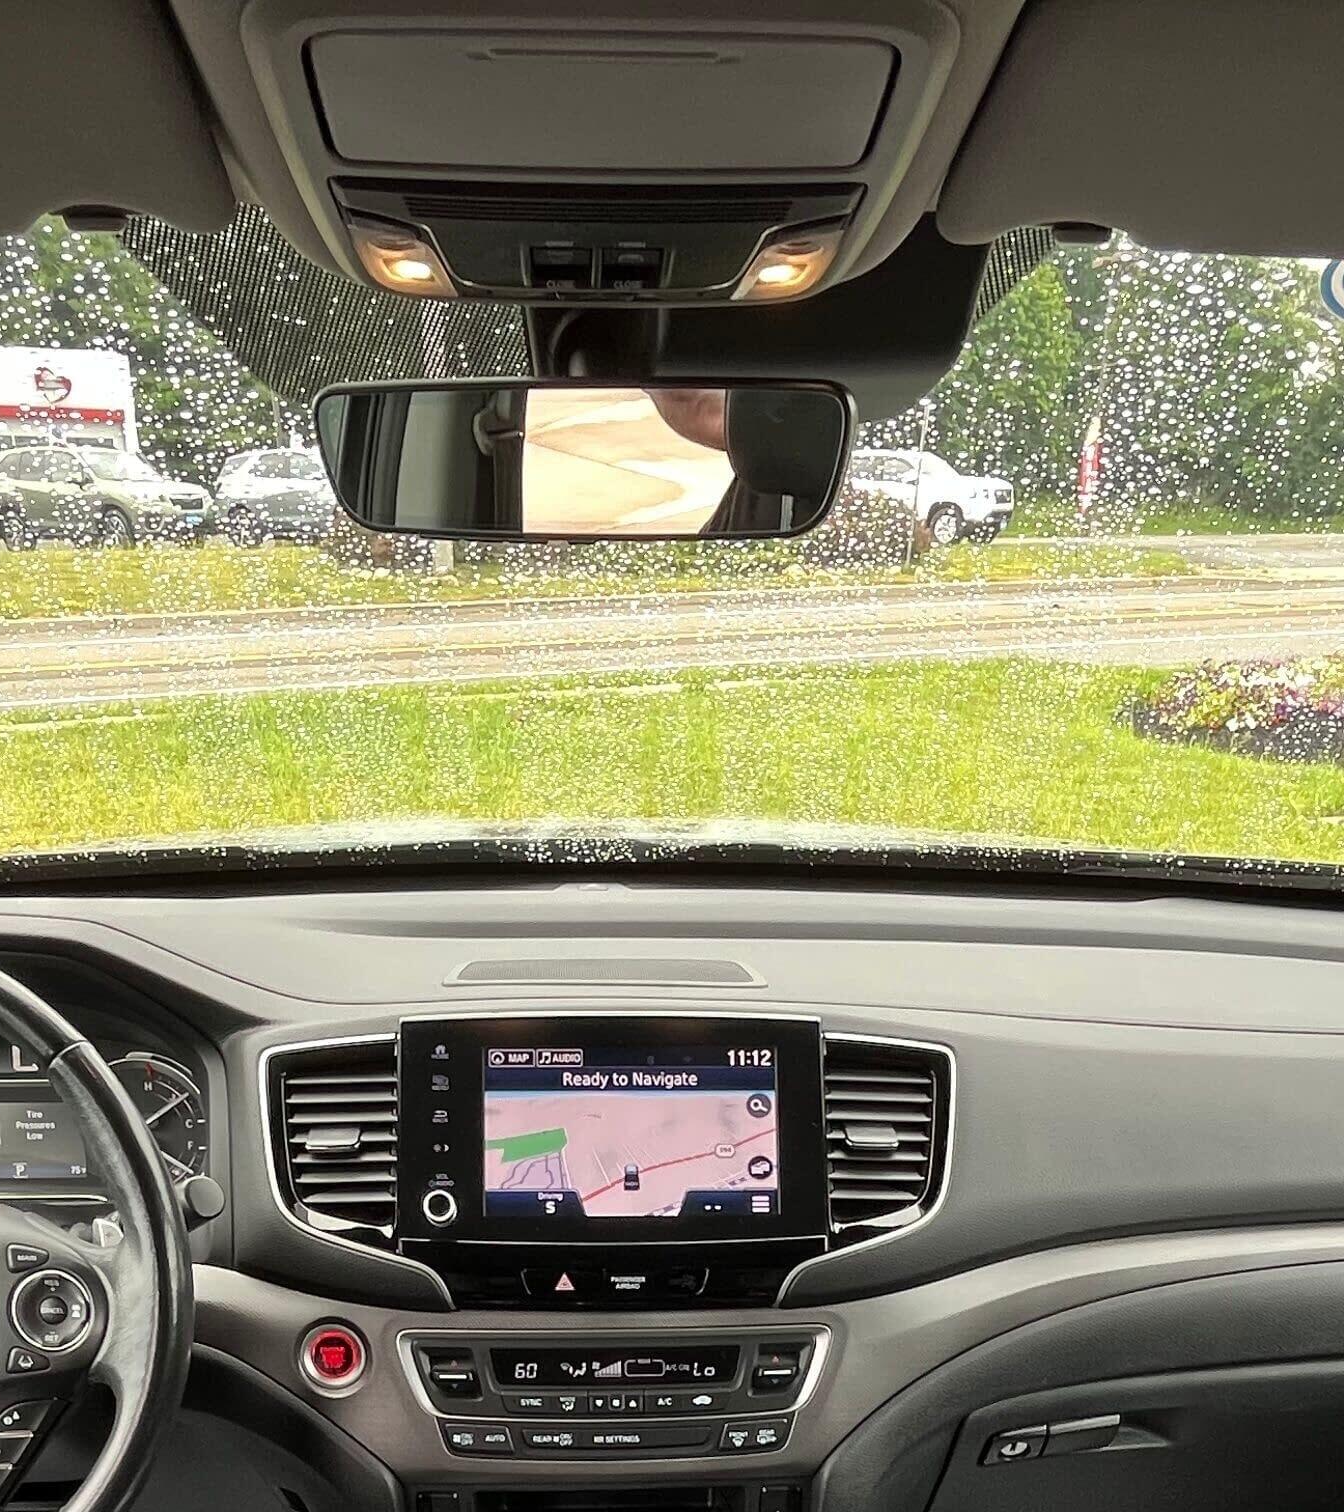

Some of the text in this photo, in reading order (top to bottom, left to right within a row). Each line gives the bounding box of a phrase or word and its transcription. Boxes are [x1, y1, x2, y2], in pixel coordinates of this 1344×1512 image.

[508, 1053, 581, 1064] MAP AUDIO
[728, 1049, 772, 1067] 11:12
[562, 1071, 698, 1090] Ready to Navigate
[144, 1082, 153, 1091] H
[26, 1110, 44, 1119] Tire
[514, 1363, 538, 1379] 60
[657, 1397, 672, 1406] A/C
[485, 1434, 506, 1443] AUTO
